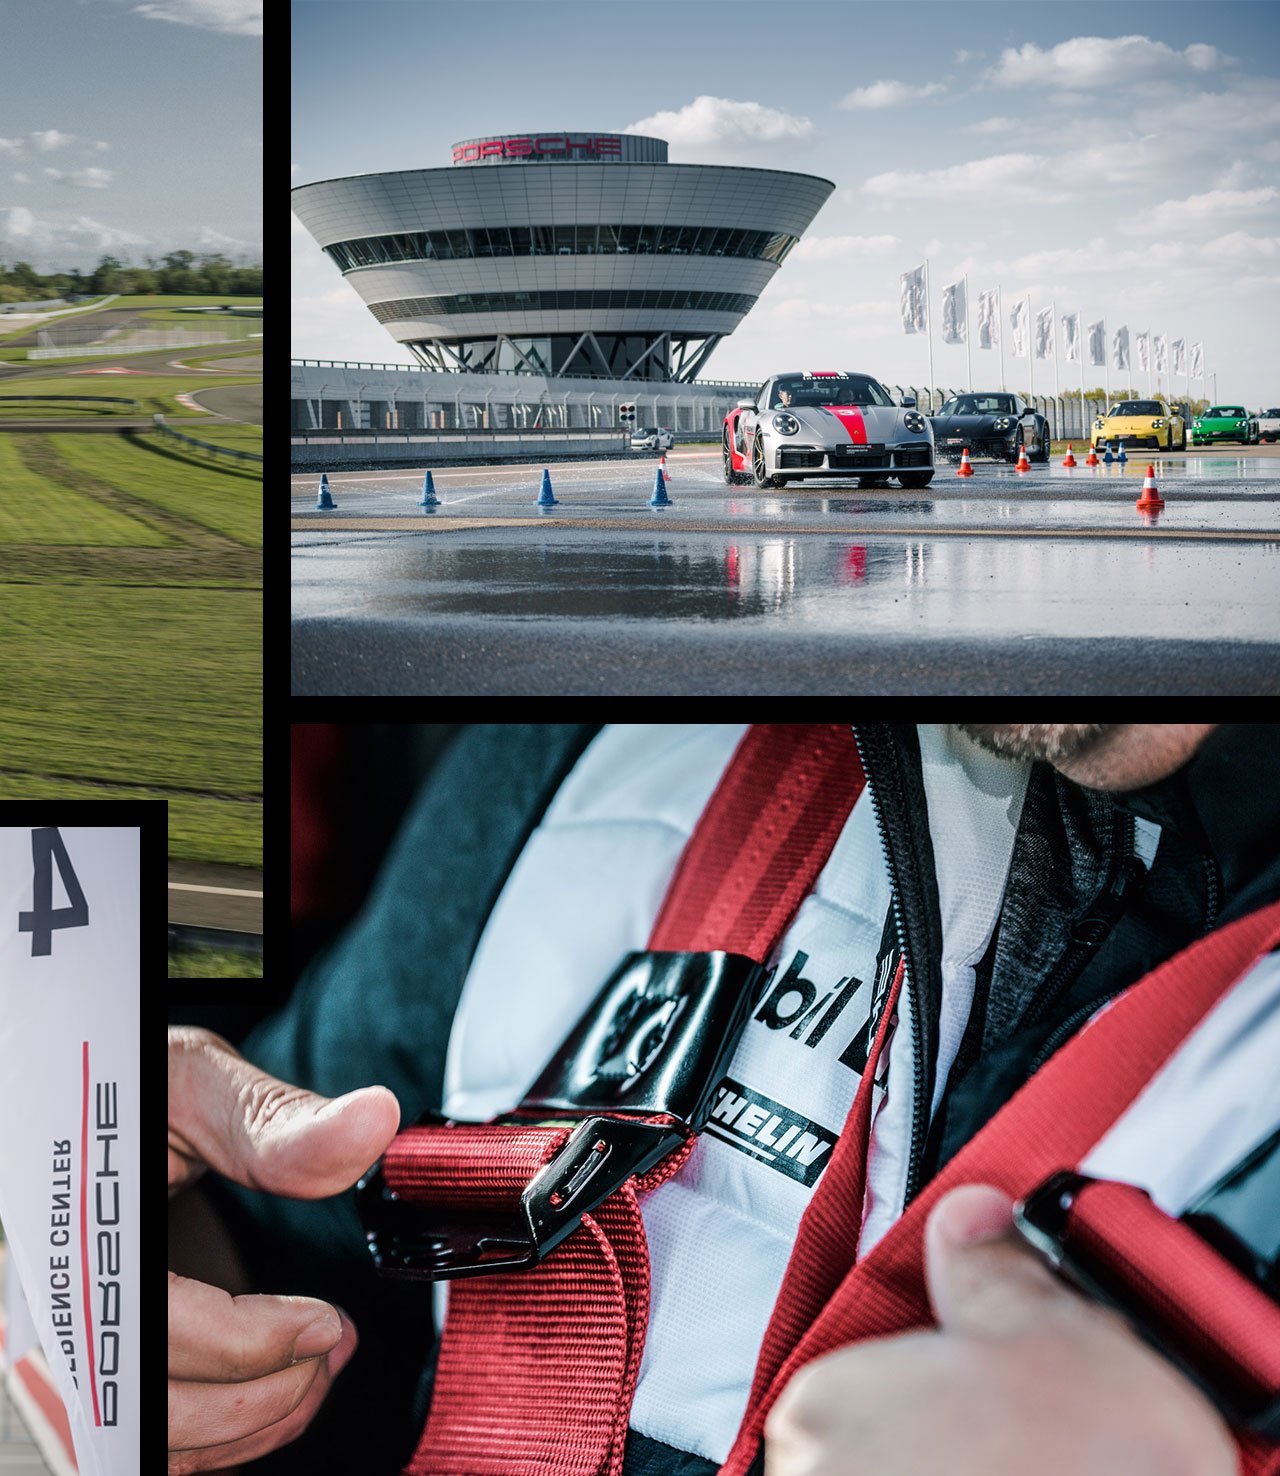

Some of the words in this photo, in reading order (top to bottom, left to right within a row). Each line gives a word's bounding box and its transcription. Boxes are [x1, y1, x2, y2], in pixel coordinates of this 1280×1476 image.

[451, 137, 622, 165] PORSCHE
[754, 949, 864, 1049] bil
[711, 1086, 832, 1167] HELIN
